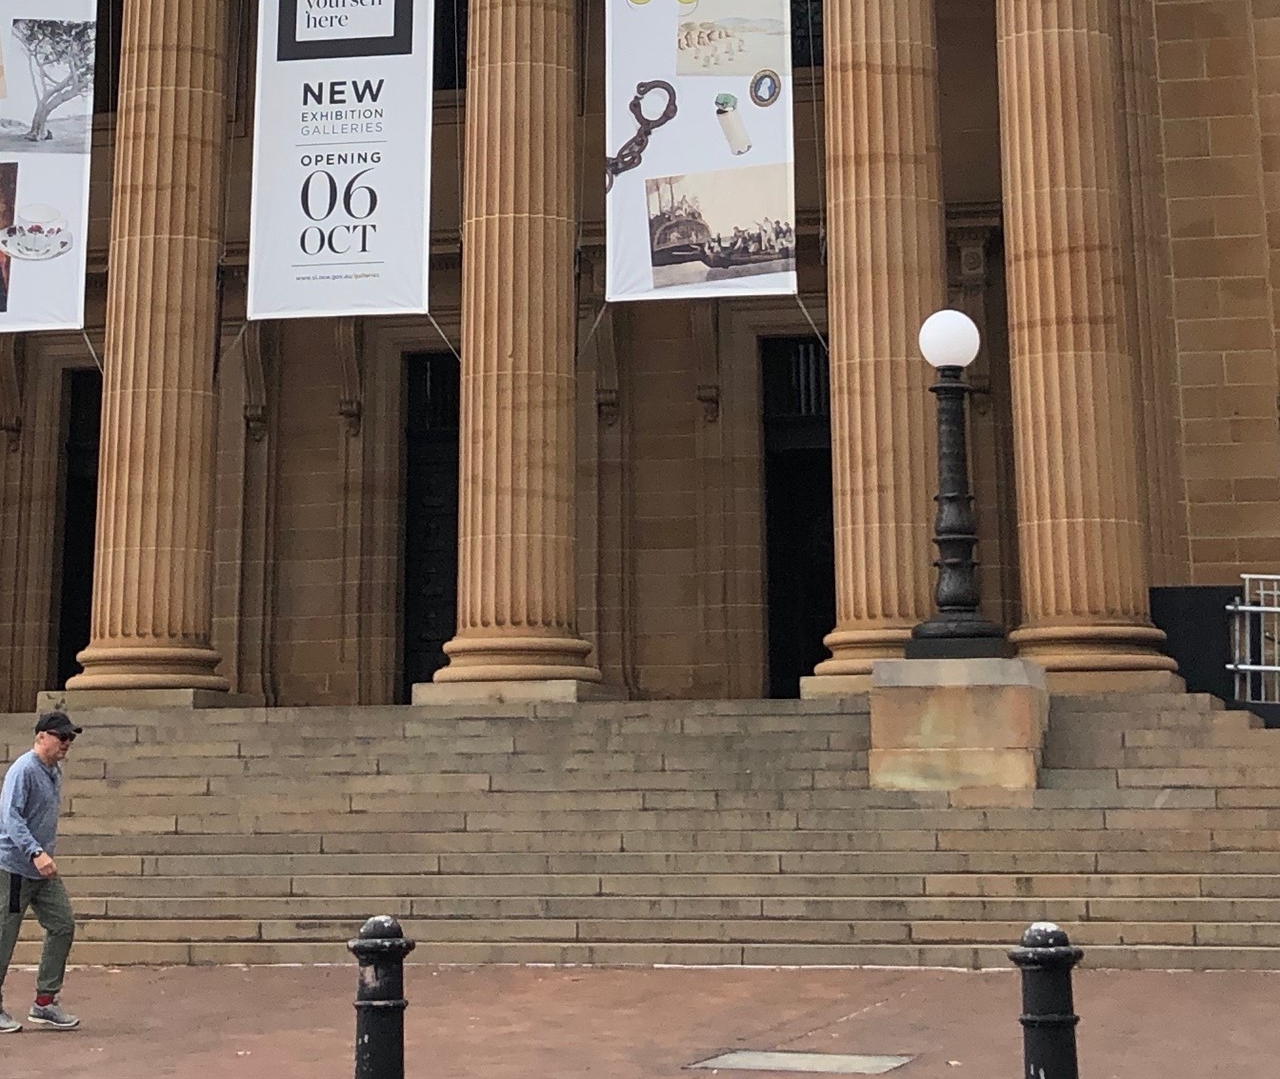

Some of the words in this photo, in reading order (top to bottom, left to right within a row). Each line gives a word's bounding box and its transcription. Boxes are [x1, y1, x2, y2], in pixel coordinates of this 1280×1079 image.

[305, 11, 349, 29] here
[302, 78, 385, 107] NEW
[301, 108, 384, 123] EXHIBITION
[300, 121, 384, 137] GALLERIES
[300, 151, 382, 167] OPENING
[300, 167, 379, 222] 06
[299, 224, 378, 256] OCT
